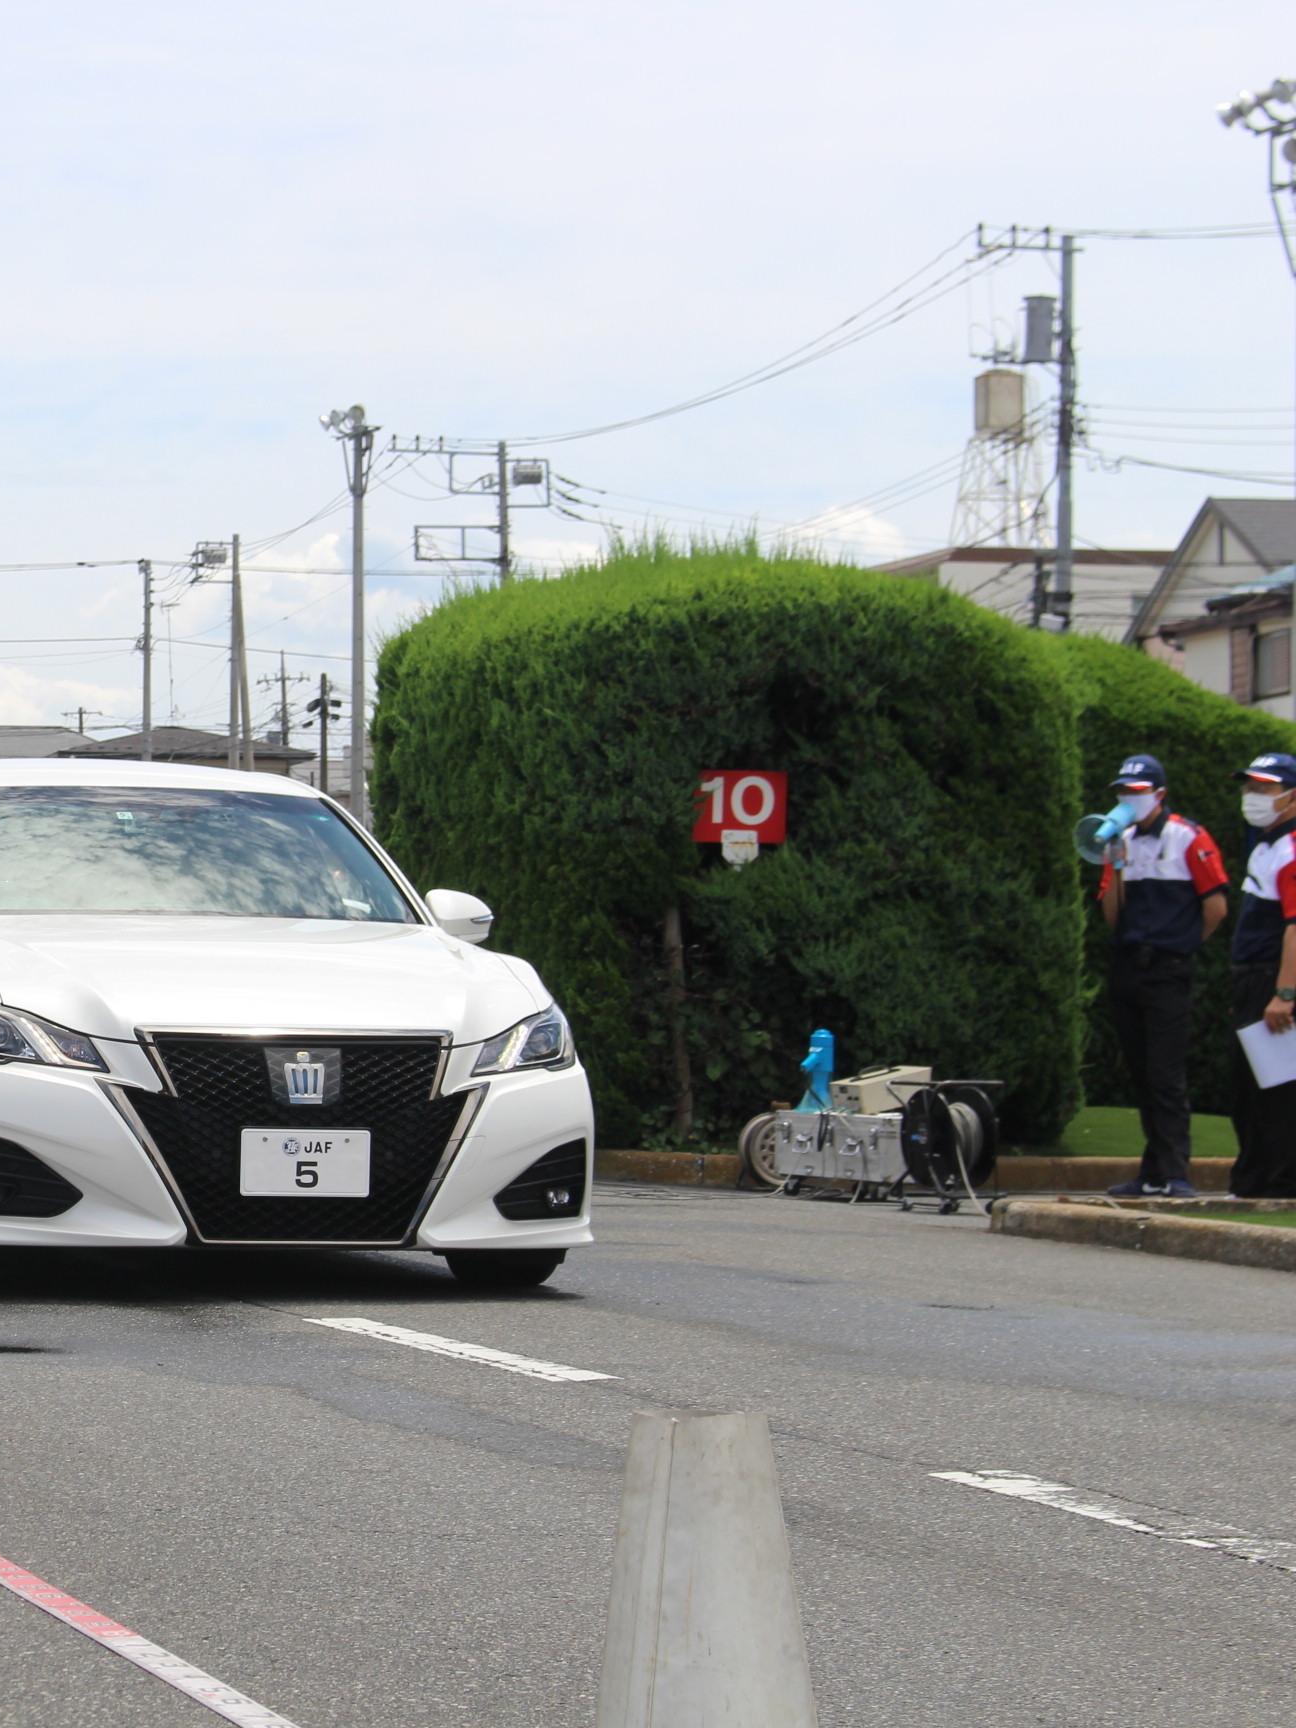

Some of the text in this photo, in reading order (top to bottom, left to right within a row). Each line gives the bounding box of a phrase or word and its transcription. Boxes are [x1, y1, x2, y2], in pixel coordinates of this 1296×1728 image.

[700, 775, 775, 825] 10
[304, 1141, 333, 1154] JAF
[295, 1161, 319, 1188] 5
